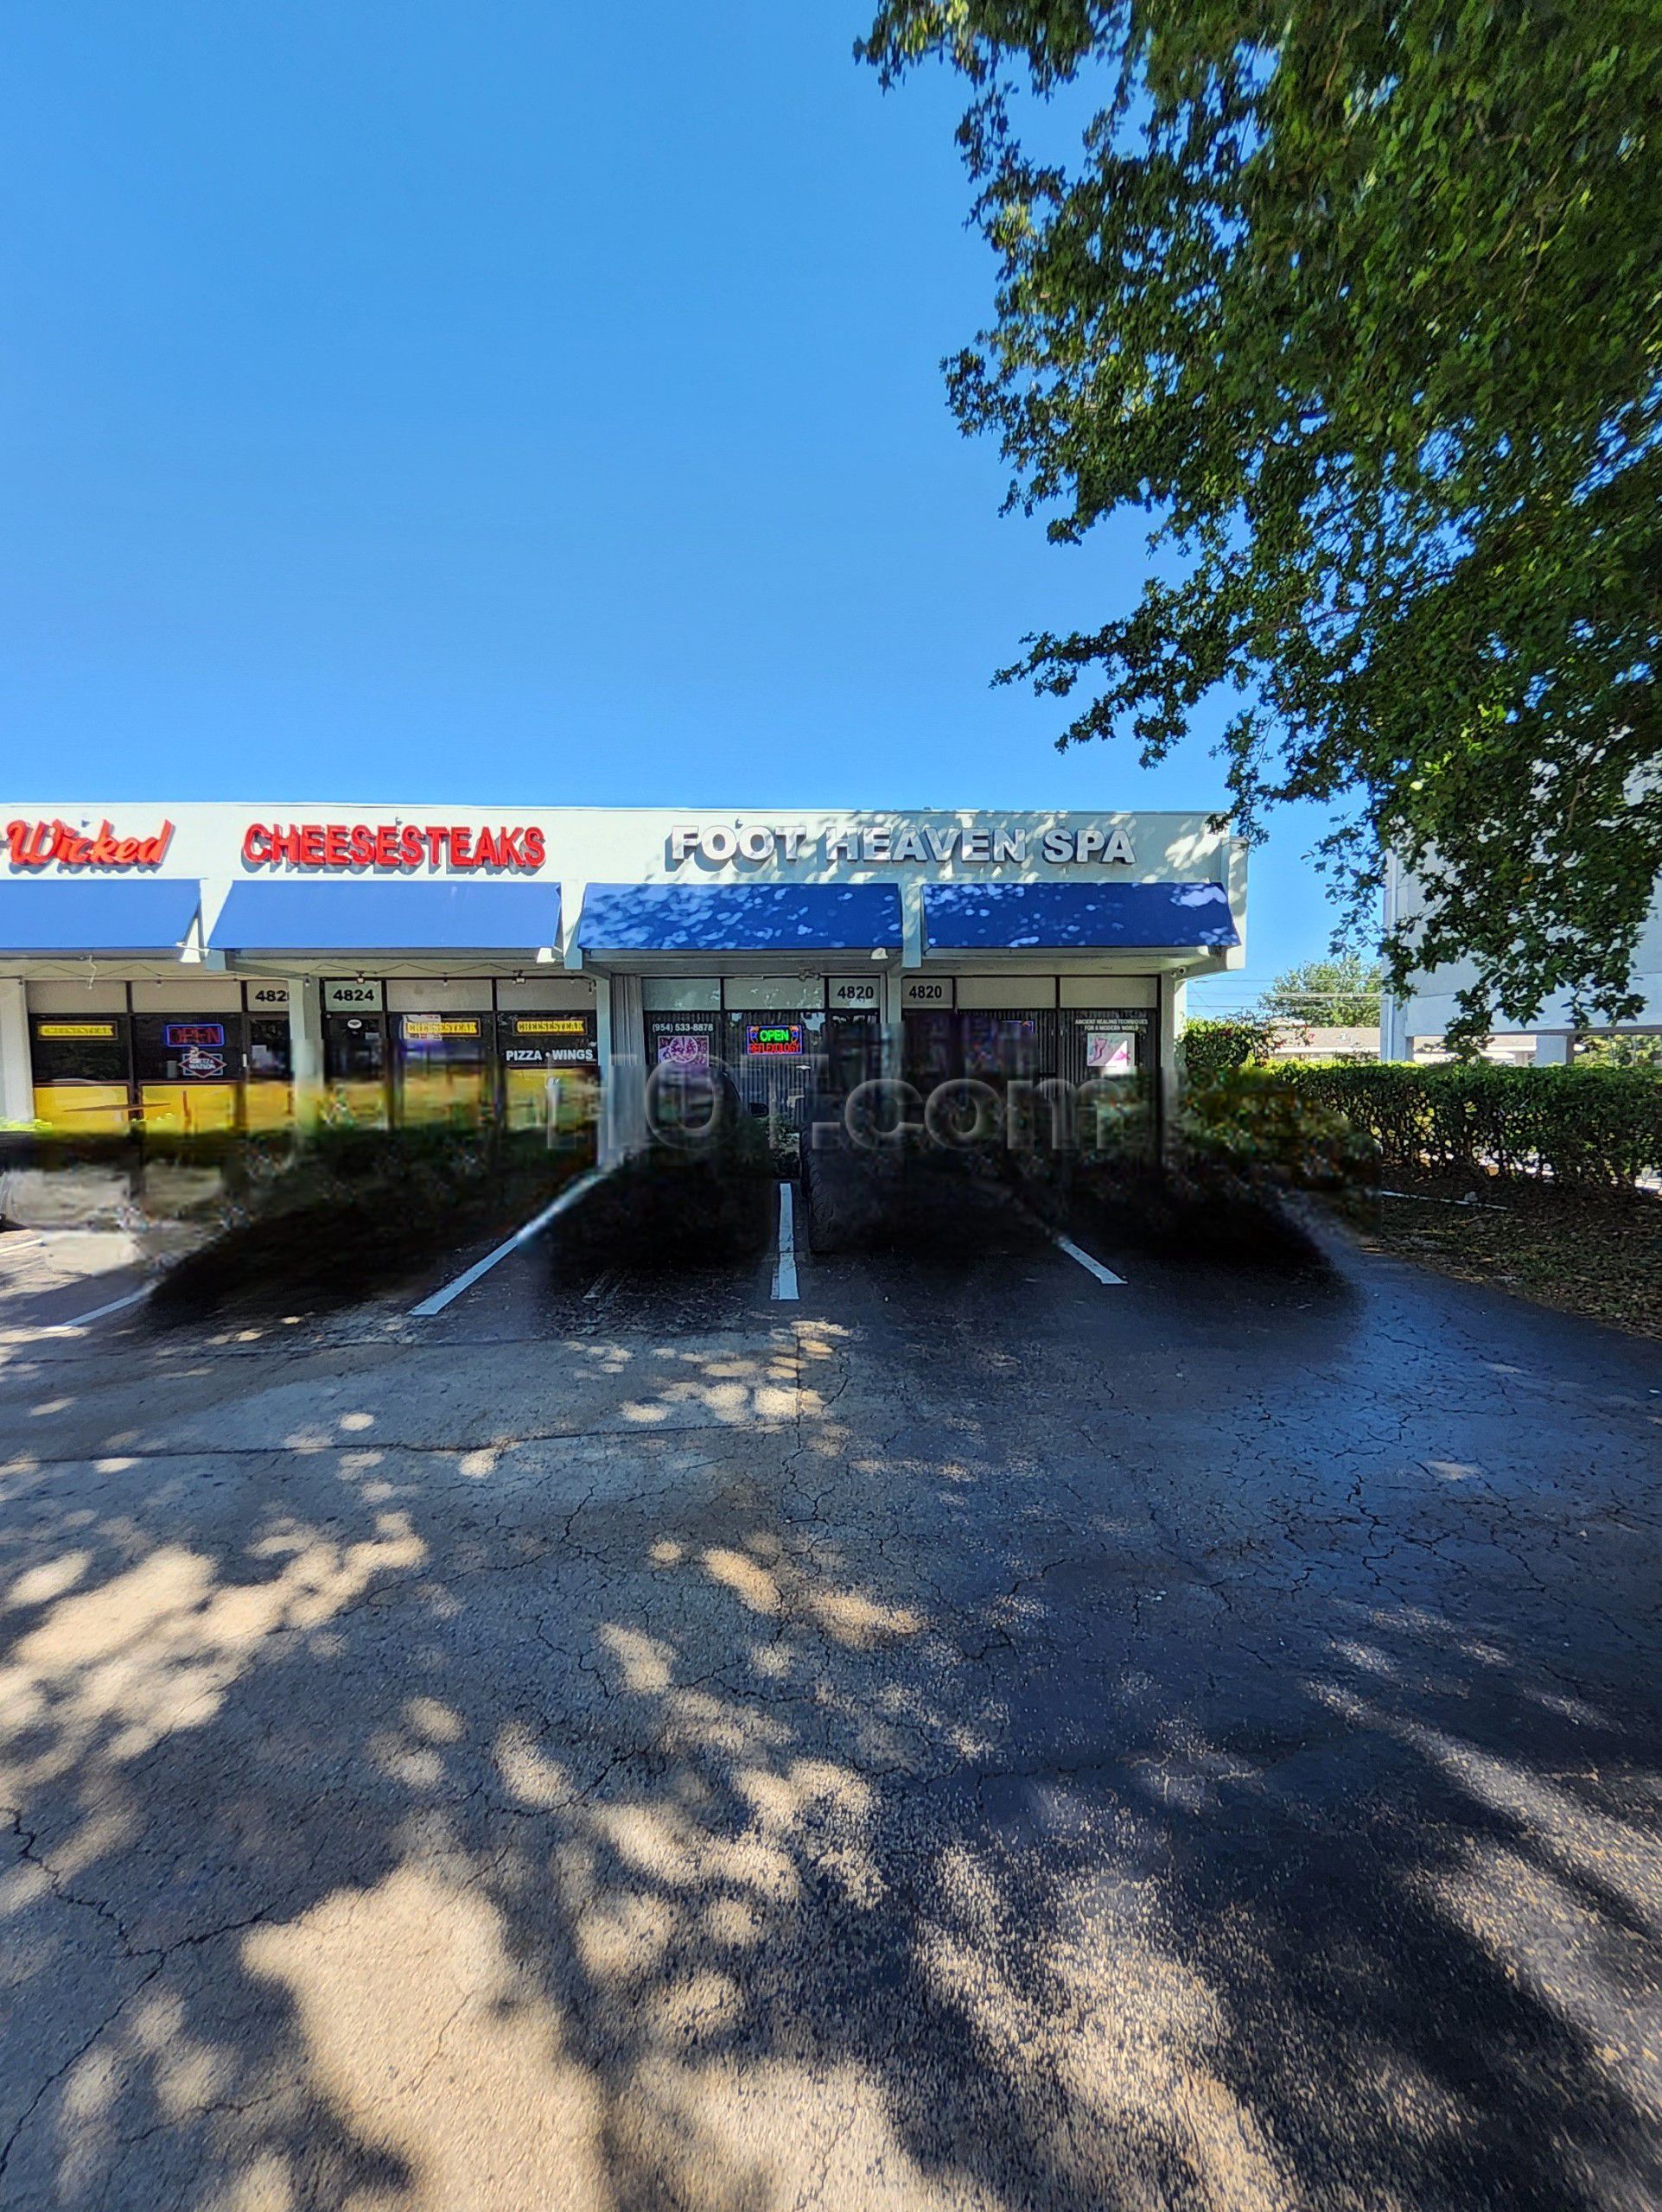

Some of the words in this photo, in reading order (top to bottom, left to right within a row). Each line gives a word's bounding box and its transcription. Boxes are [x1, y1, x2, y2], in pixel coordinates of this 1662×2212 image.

[7, 818, 175, 863] Wicked
[243, 823, 547, 868] CHEESESTEAKS
[672, 825, 807, 861] FOOT
[825, 826, 1026, 863] HEAVEN
[1043, 828, 1137, 864] SPA
[255, 989, 289, 1002] 482
[333, 989, 375, 1001] 4824
[837, 985, 875, 1000] 4820
[908, 985, 943, 999] 4820
[516, 1020, 584, 1033] CHEESESTEAK
[652, 1023, 673, 1033] (954)
[675, 1023, 714, 1032] 533-8878
[169, 1027, 222, 1044] OPEN
[759, 1029, 790, 1043] OPEN
[506, 1050, 543, 1061] PIZZA
[551, 1049, 594, 1061] WINGS
